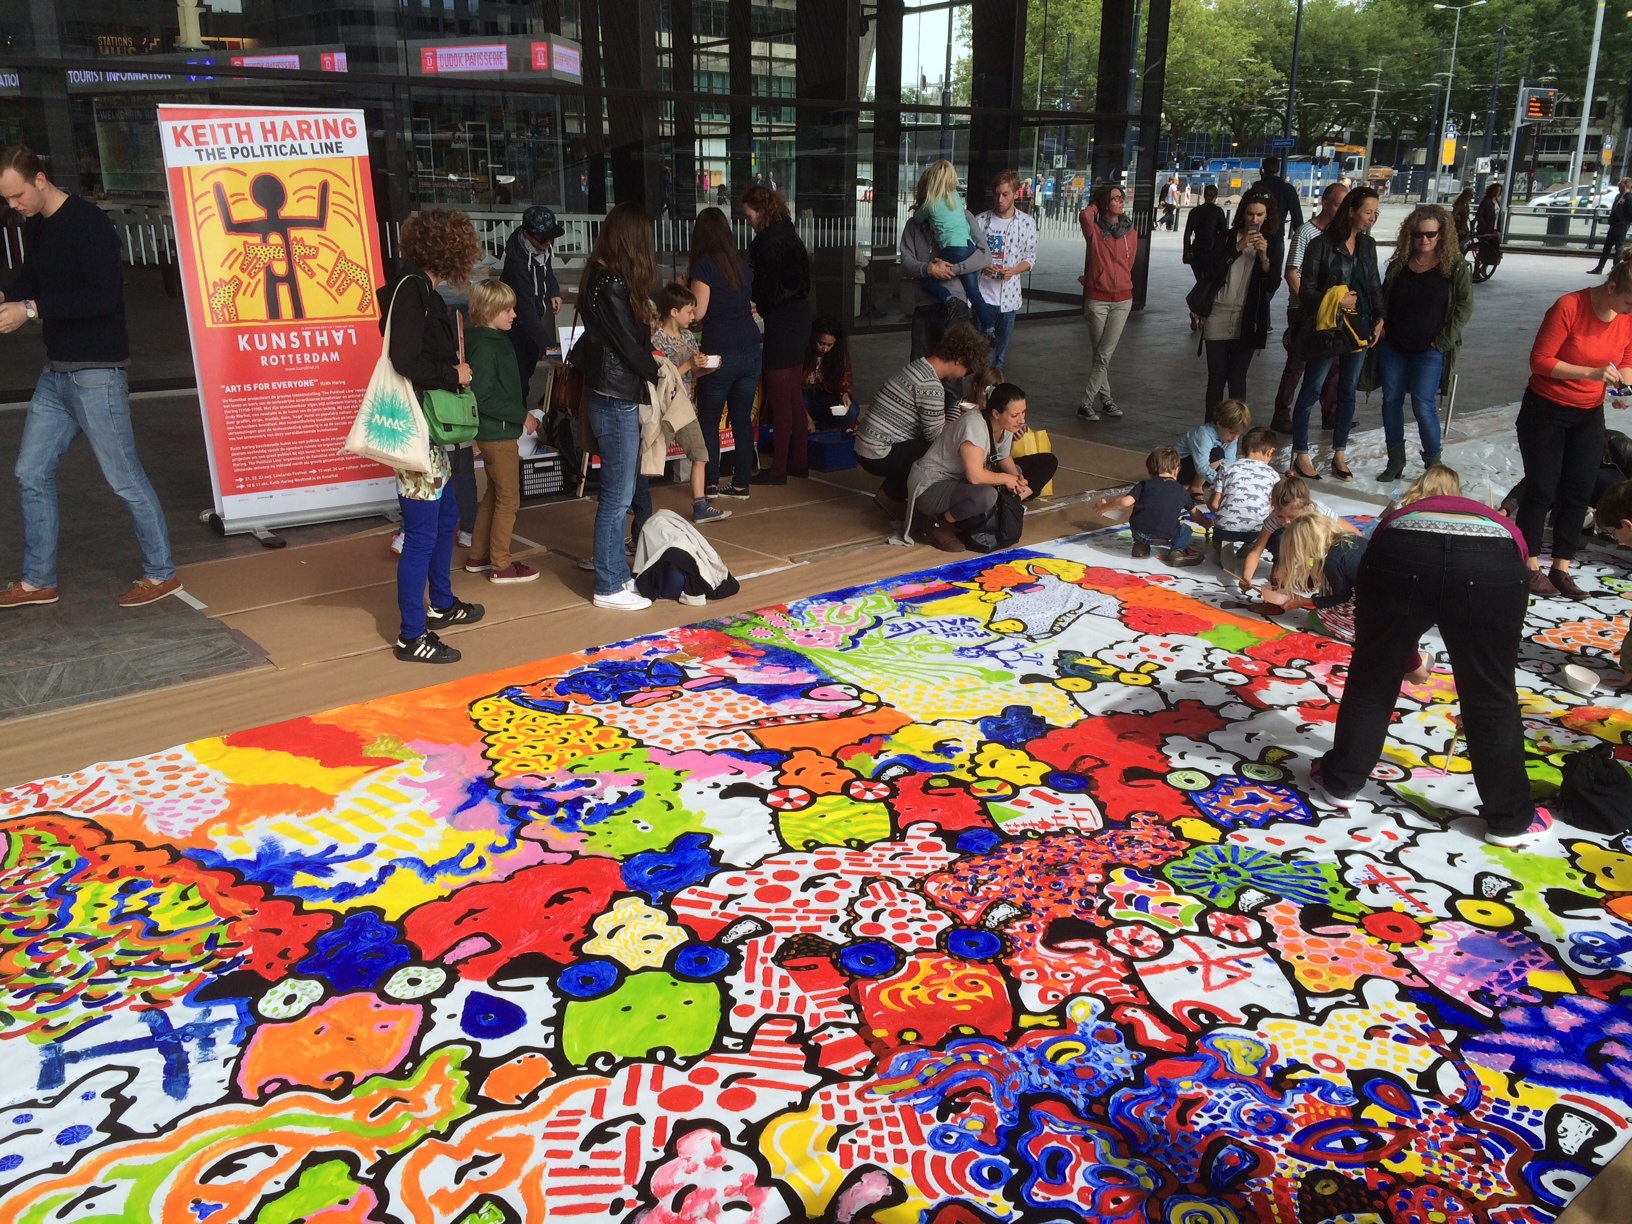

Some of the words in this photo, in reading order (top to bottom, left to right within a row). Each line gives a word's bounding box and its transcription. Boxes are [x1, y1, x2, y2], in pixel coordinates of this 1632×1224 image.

[98, 36, 133, 46] STATIONS
[440, 53, 463, 68] DUDOK
[464, 51, 504, 67] PATISSERIE
[68, 70, 103, 83] TOURIST
[172, 122, 254, 147] KEITH
[260, 118, 357, 143] HARING
[195, 147, 227, 161] THE
[231, 143, 308, 159] POLITICAL
[310, 142, 344, 154] LINE
[238, 329, 357, 351] KUNSTHAL
[261, 352, 340, 366] ROTTERDAM
[254, 382, 270, 391] FOR
[885, 617, 981, 634] WALTER
